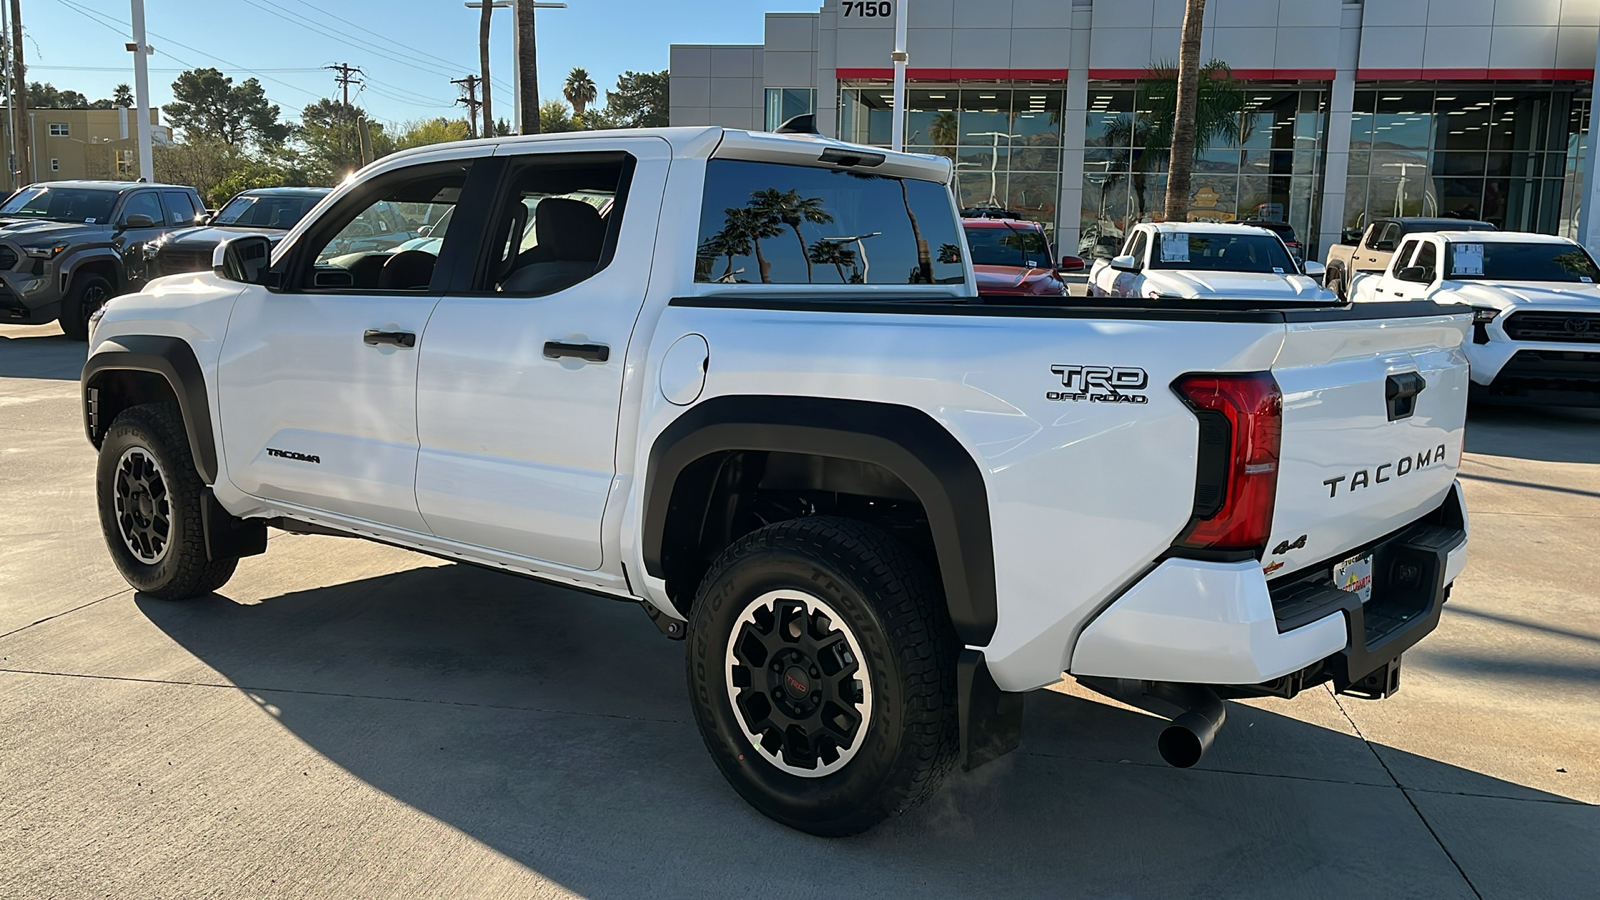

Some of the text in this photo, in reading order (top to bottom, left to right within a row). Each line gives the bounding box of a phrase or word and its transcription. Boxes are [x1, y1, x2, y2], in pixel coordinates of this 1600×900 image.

[842, 1, 891, 17] 7150
[1051, 364, 1148, 393] TRD
[1046, 391, 1148, 405] OFF ROAD
[266, 447, 321, 464] TACOMA
[1323, 444, 1446, 498] TACOMA
[787, 674, 806, 692] TRD
